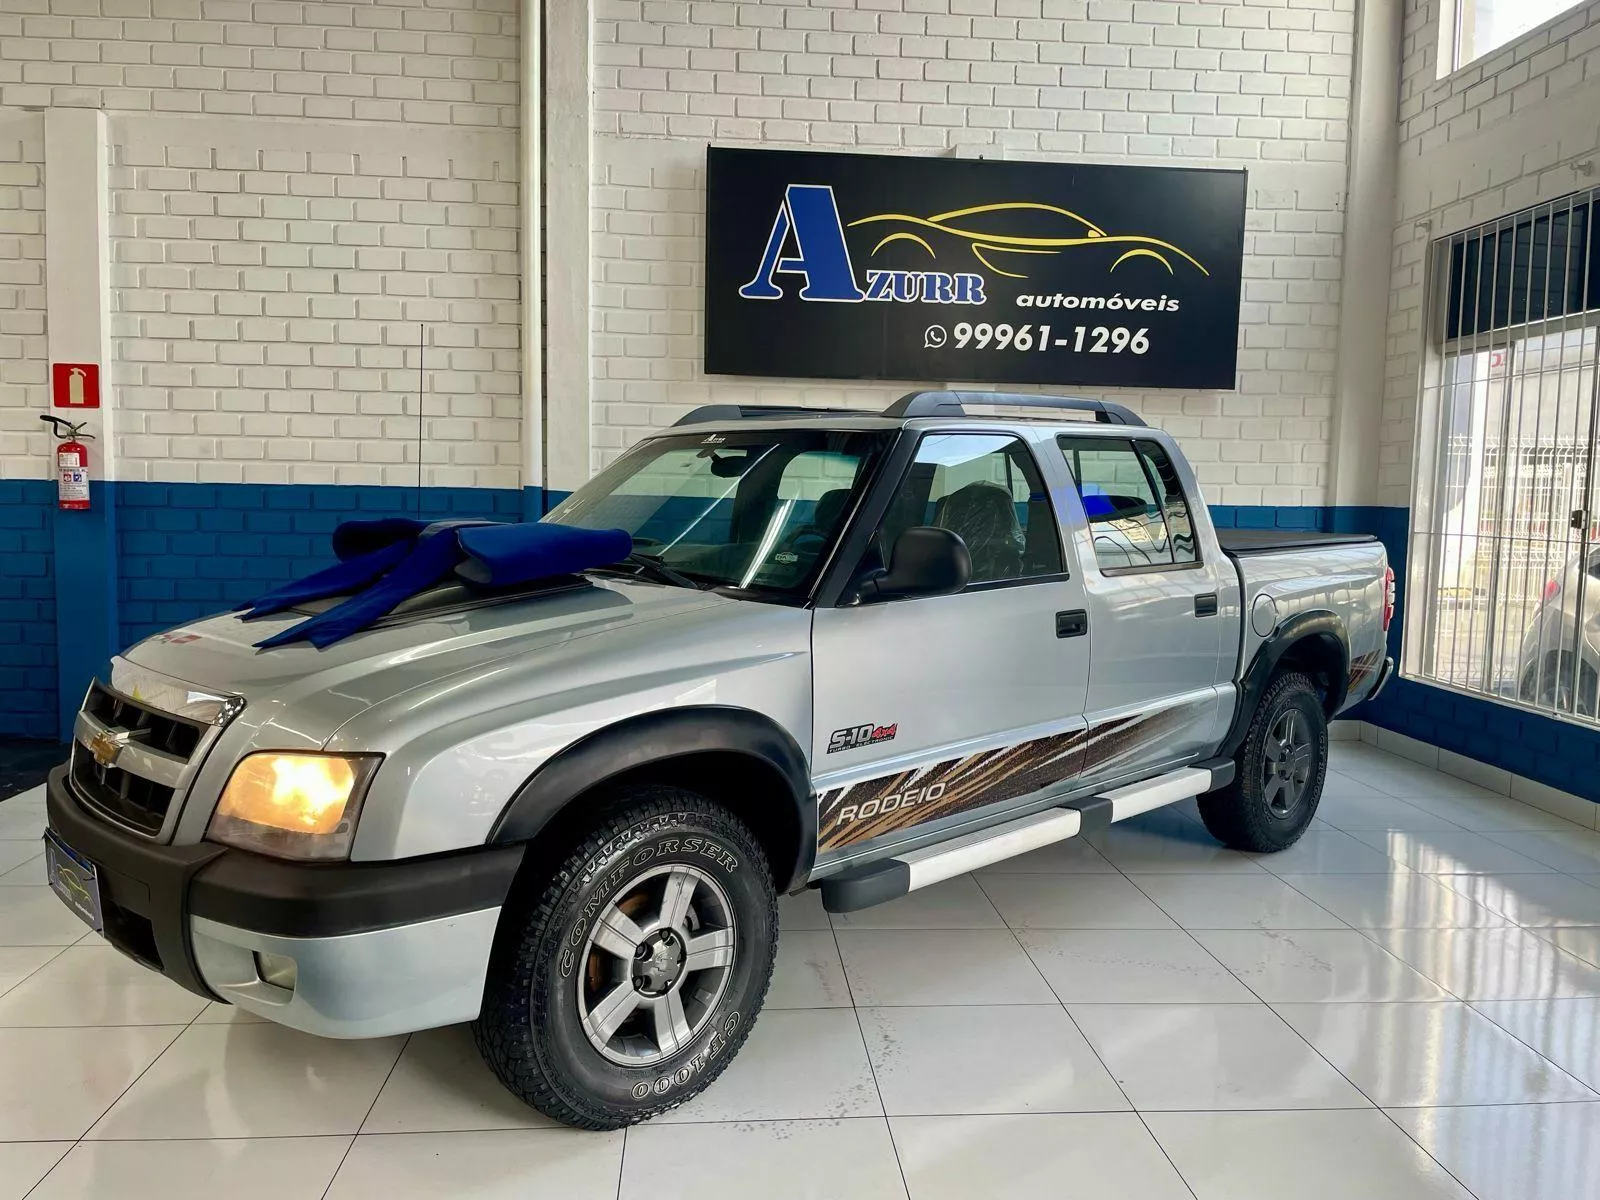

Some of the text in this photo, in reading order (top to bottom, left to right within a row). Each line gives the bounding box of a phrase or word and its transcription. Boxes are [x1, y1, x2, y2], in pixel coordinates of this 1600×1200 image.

[1016, 293, 1180, 312] automóveis
[953, 322, 1150, 355] 99961-1296
[836, 782, 946, 826] RODEIO
[561, 838, 738, 978] COMFORSER
[630, 1011, 741, 1100] CF1000
